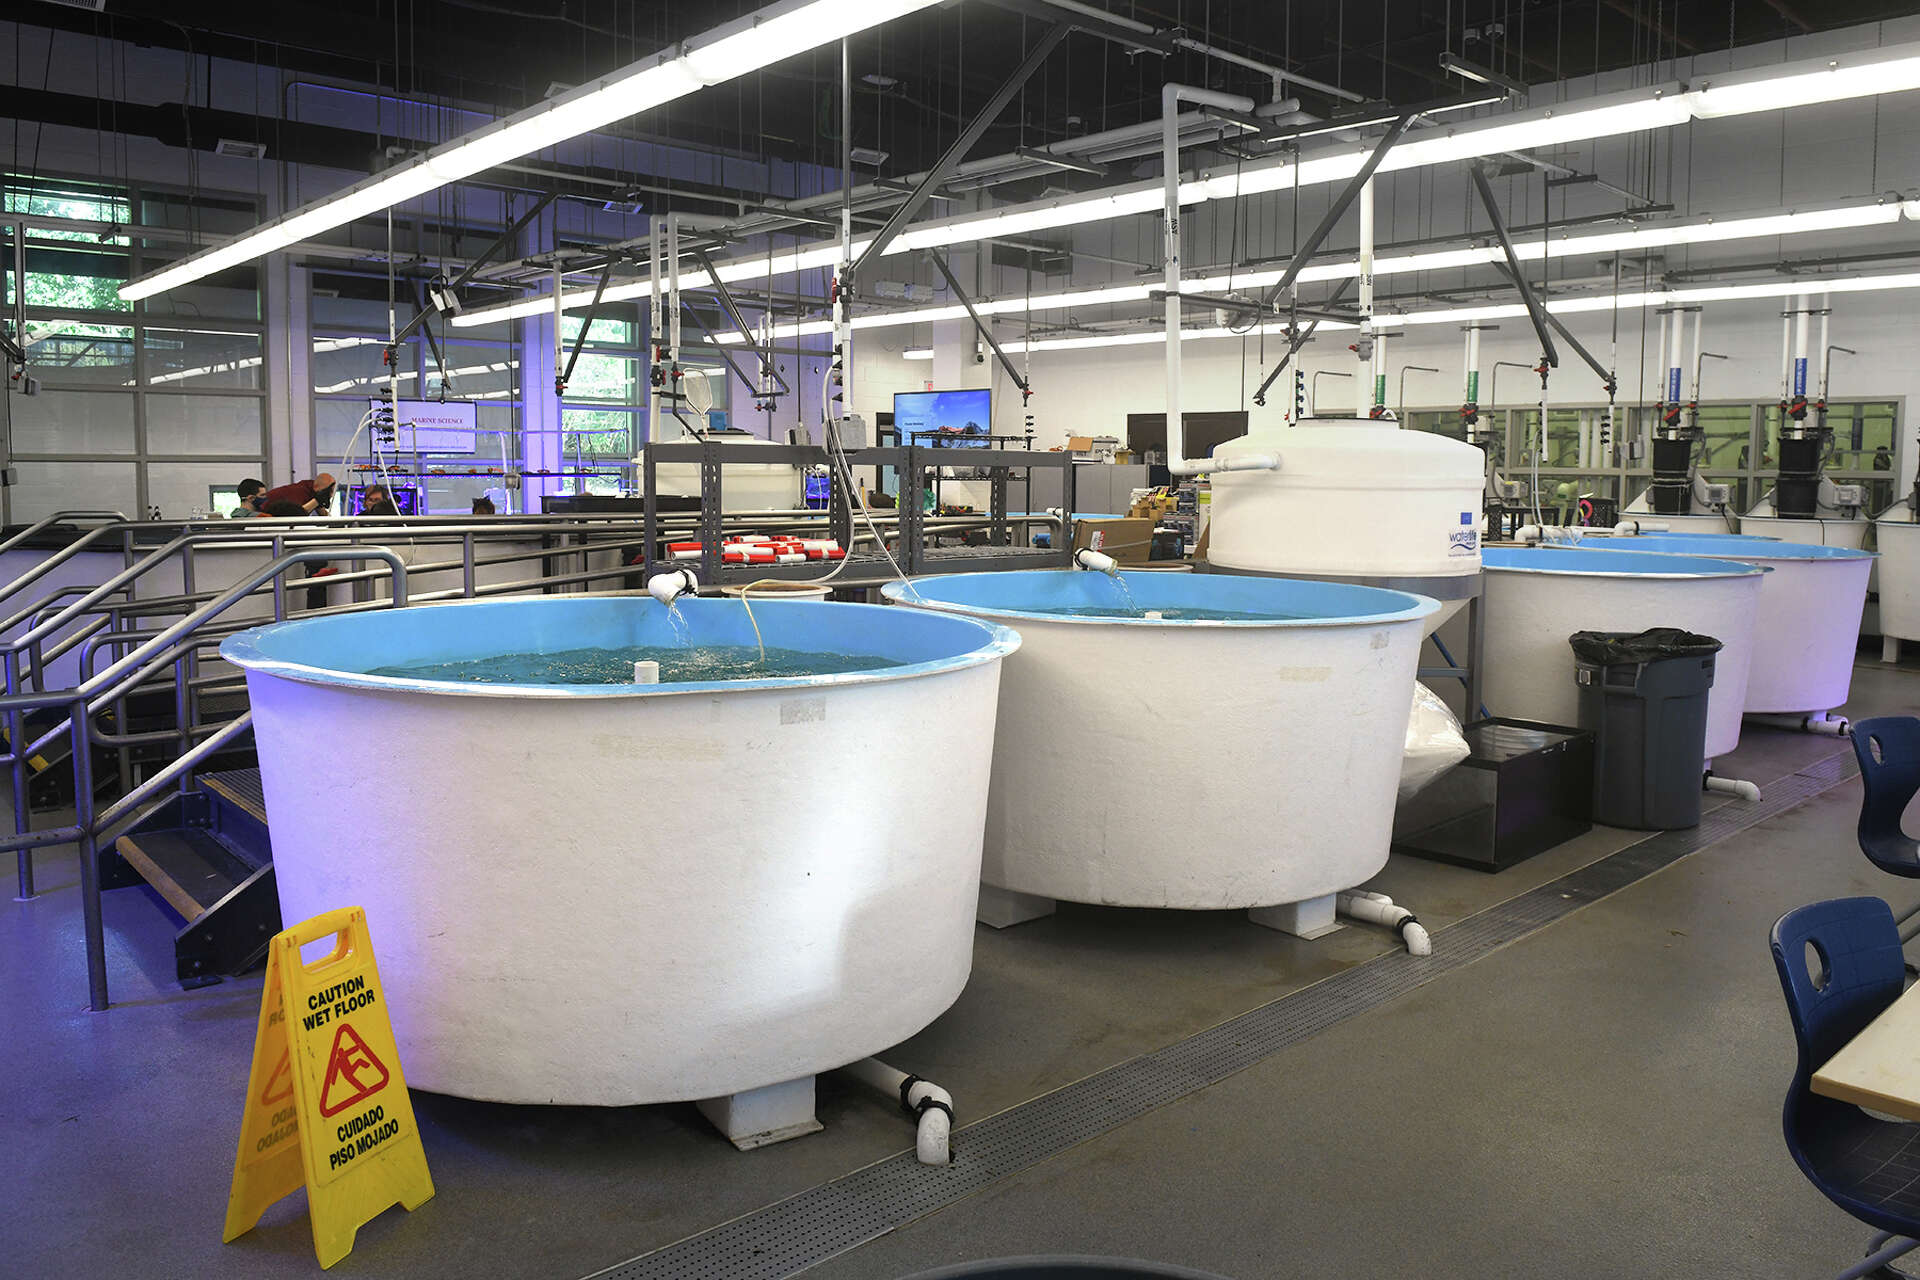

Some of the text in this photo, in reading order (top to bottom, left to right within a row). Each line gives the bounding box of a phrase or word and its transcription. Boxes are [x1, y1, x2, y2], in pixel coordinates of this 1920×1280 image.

[411, 416, 437, 424] MARINE
[302, 1007, 331, 1032] WET
[334, 989, 375, 1018] FLOOR
[308, 975, 365, 1010] CAUTION
[337, 1105, 384, 1142] CUIDADO
[329, 1118, 399, 1171] PISO MOJADO
